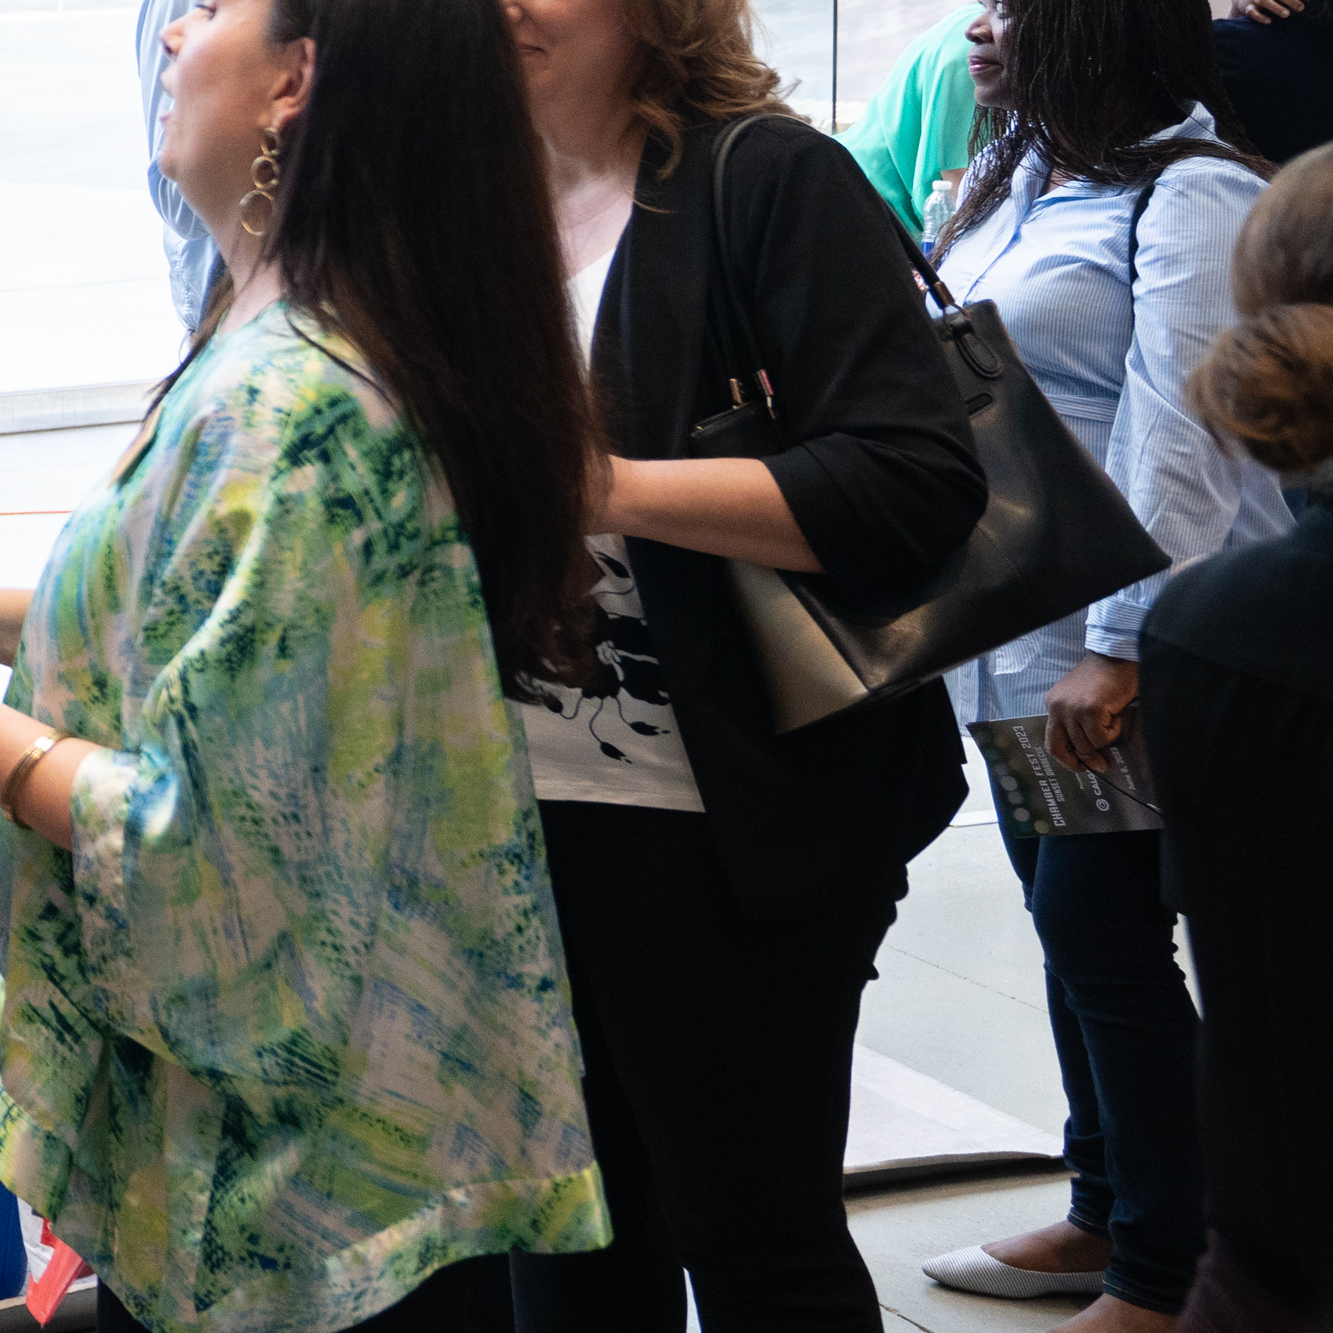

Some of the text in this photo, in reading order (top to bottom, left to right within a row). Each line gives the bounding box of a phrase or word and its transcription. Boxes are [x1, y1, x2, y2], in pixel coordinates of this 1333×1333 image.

[1012, 725, 1066, 827] CHAMBER FEST 2023
[1086, 769, 1101, 795] CALG
